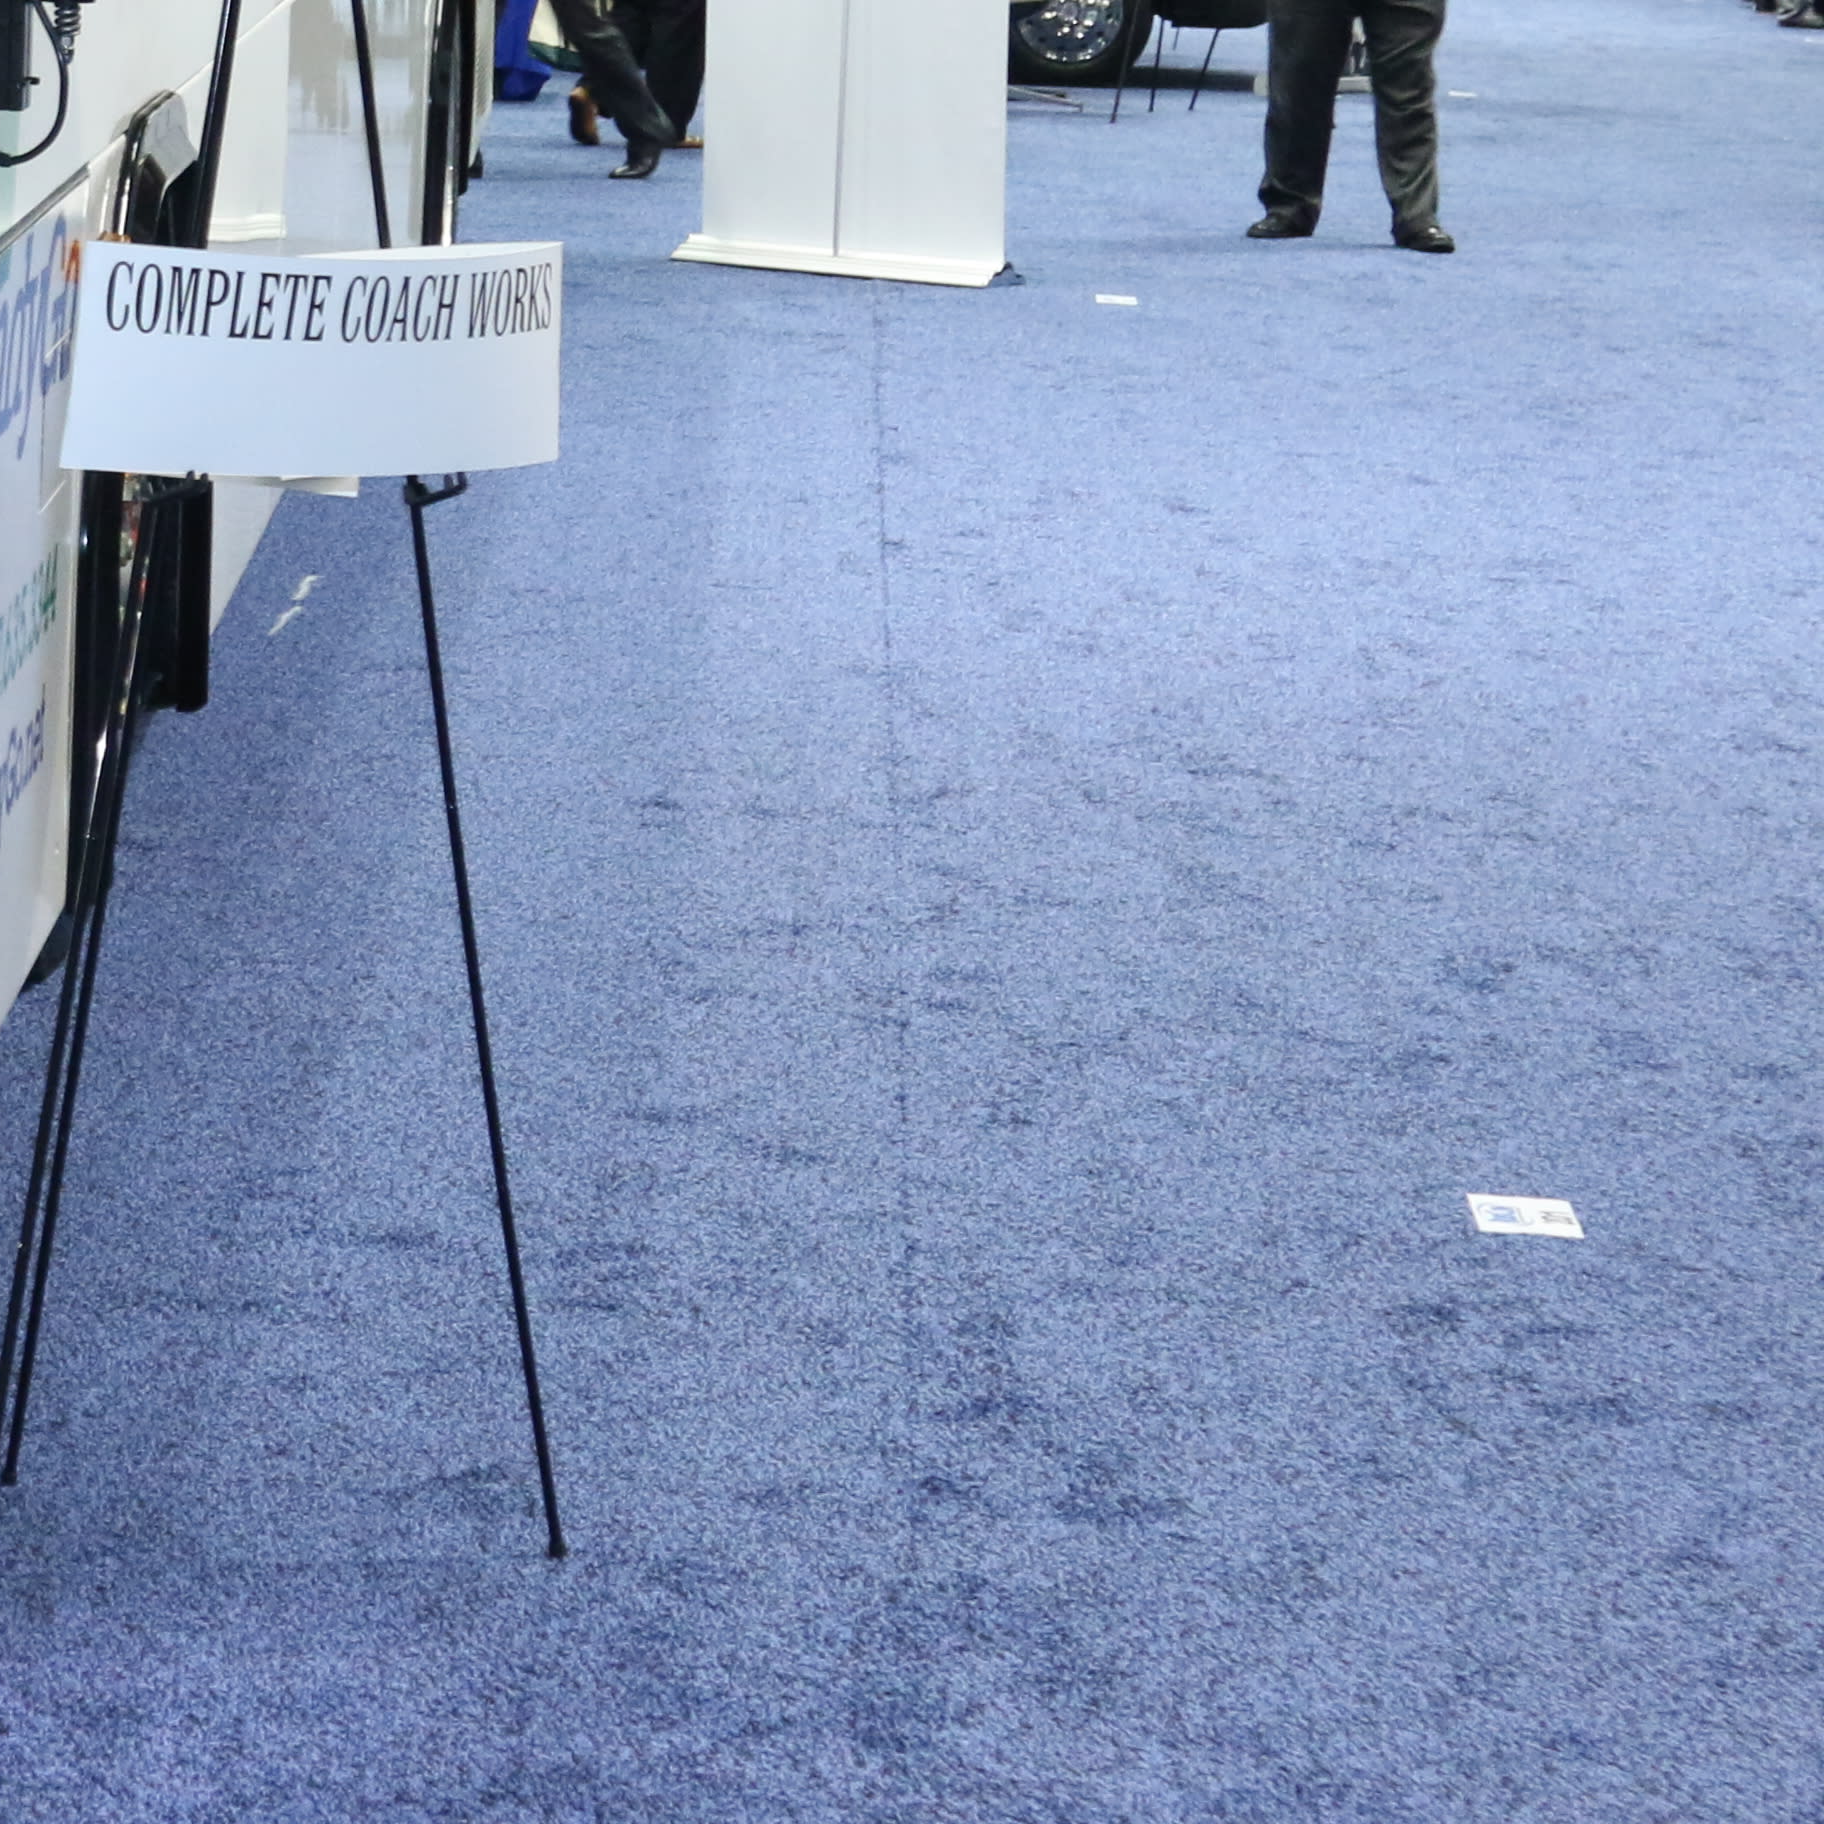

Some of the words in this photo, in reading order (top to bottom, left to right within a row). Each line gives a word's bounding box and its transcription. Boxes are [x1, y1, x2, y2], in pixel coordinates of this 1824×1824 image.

[105, 260, 333, 342] COMPLETE
[339, 273, 460, 344] COACH
[466, 260, 553, 340] WORKS
